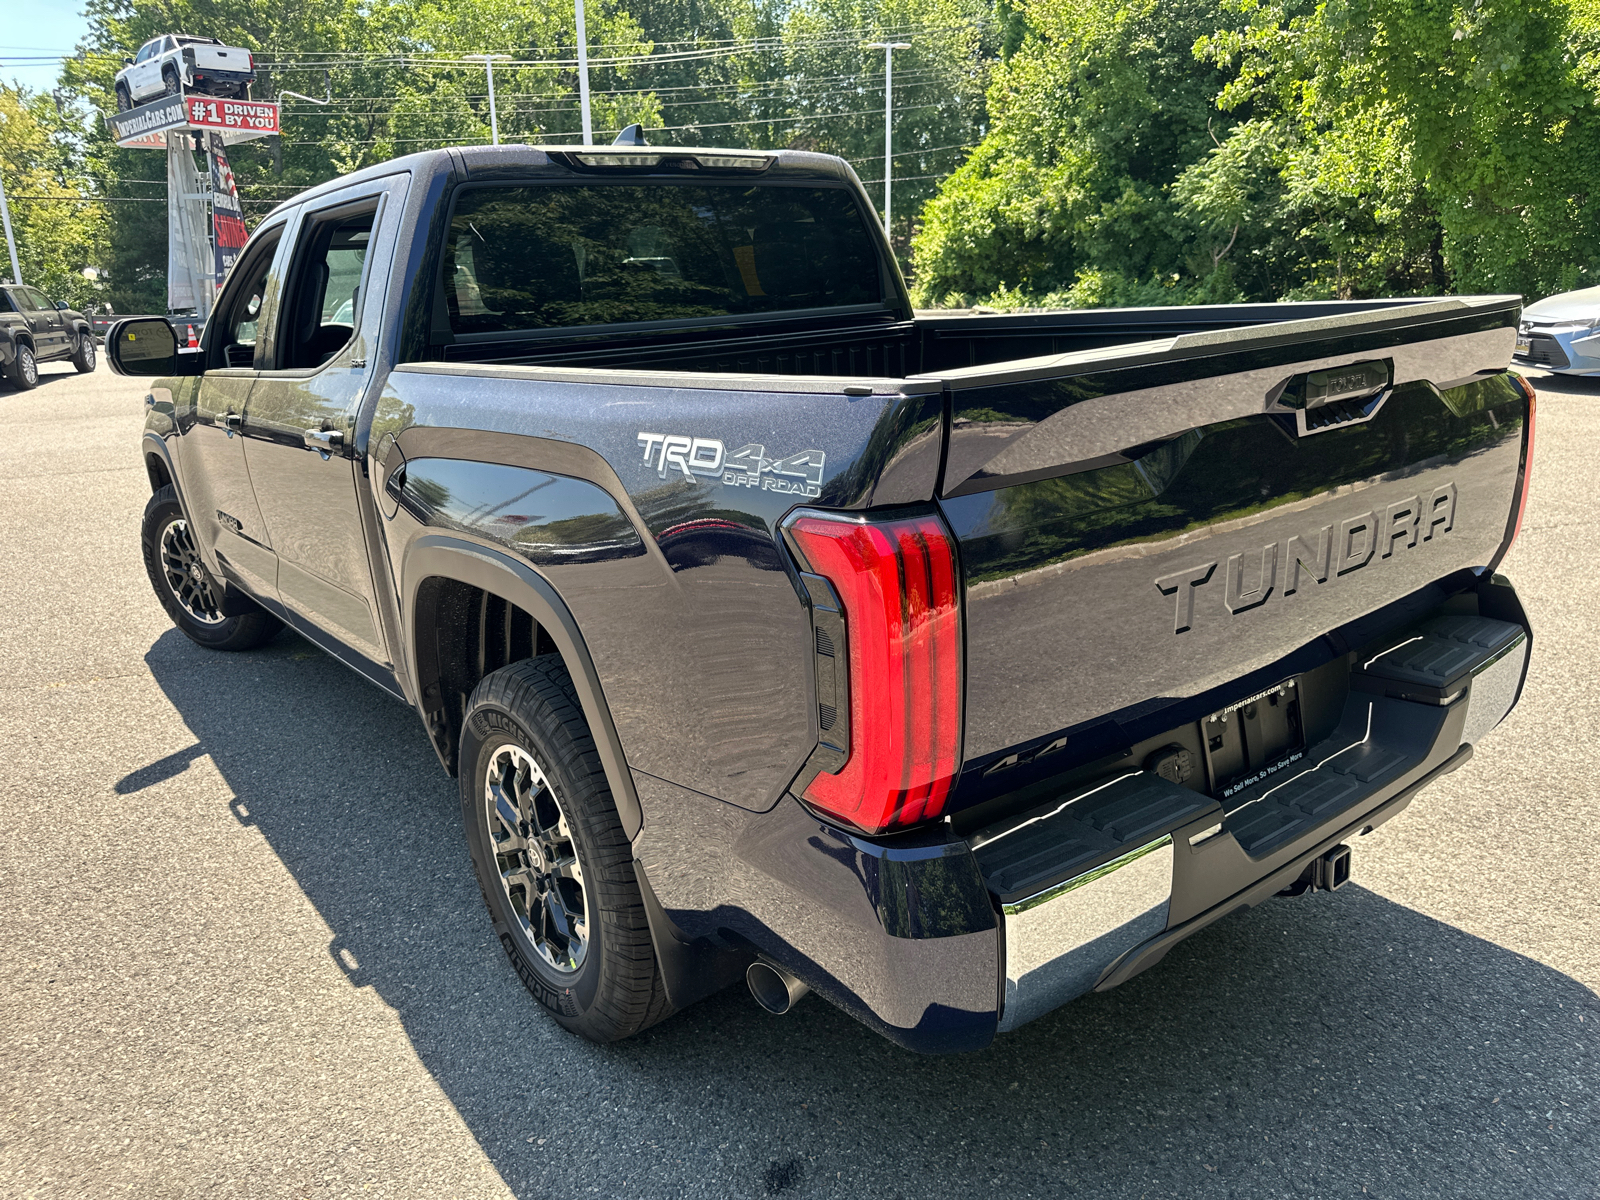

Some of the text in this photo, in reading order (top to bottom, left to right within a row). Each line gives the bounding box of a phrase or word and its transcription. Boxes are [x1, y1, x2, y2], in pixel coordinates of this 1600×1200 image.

[192, 102, 221, 123] #1
[224, 103, 274, 118] DRIVEN
[225, 114, 274, 129] BY YOU
[637, 431, 826, 486] TRD 4x4
[722, 472, 822, 498] OFF ROAD
[1154, 481, 1458, 635] TUNDRA
[488, 712, 547, 773] MICHELIN
[1223, 786, 1233, 797] We
[1234, 782, 1244, 793] Sell
[1259, 770, 1267, 779] So
[1267, 764, 1278, 775] You
[1278, 759, 1290, 769] Save
[1289, 752, 1303, 762] More
[503, 937, 559, 1011] MICHELIN
